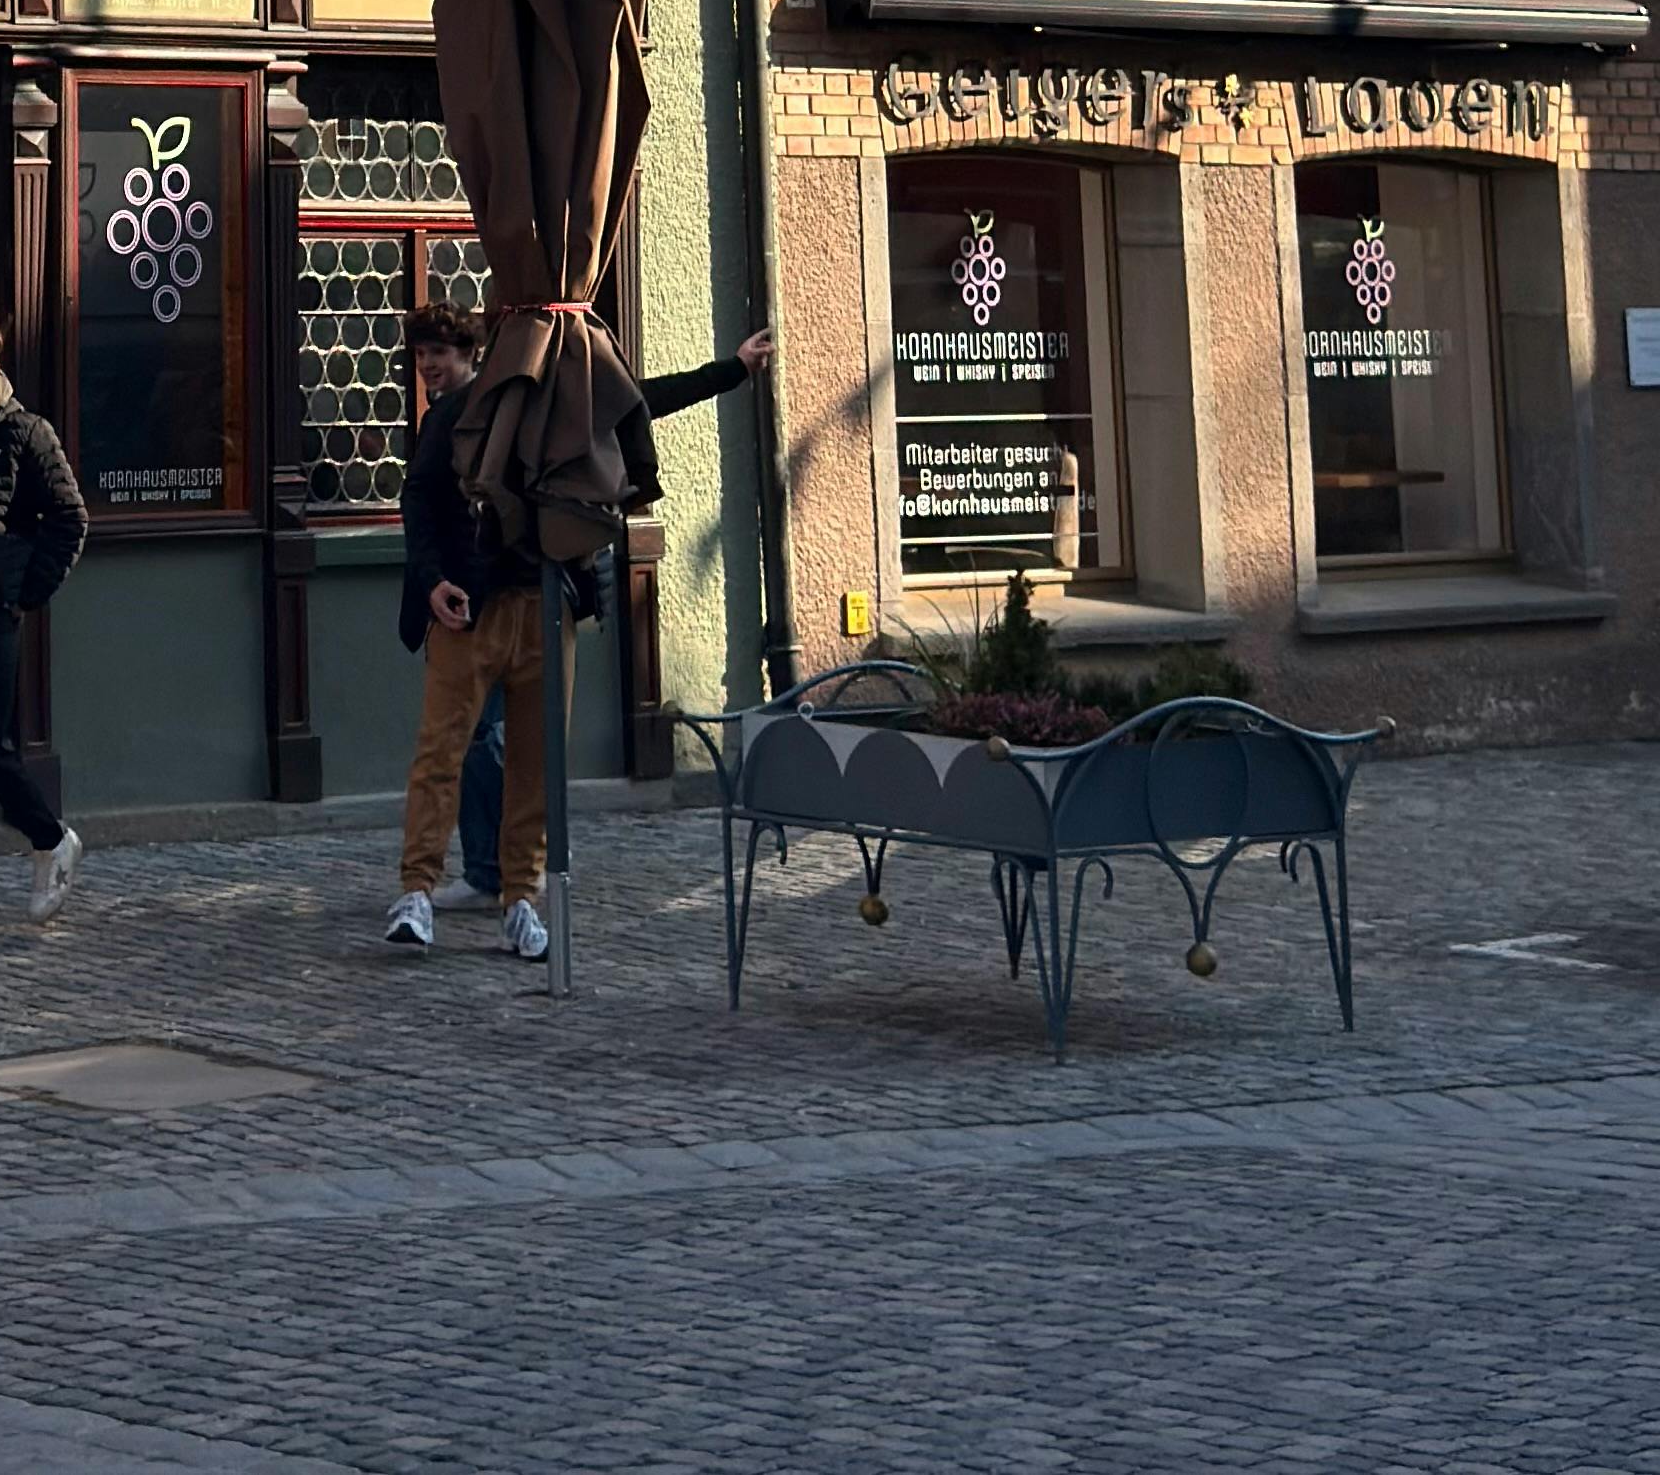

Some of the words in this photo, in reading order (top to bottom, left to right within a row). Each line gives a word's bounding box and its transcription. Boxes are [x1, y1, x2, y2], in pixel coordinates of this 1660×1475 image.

[896, 332, 1069, 361] KORNHAUSMEISTER
[914, 364, 940, 381] WEIN
[956, 364, 995, 381] WHISKY
[906, 443, 998, 466] Mitarbeiter
[99, 468, 222, 489] KORNHAUSMEISTER
[920, 468, 1033, 492] Bewerbungen
[1039, 471, 1058, 487] an
